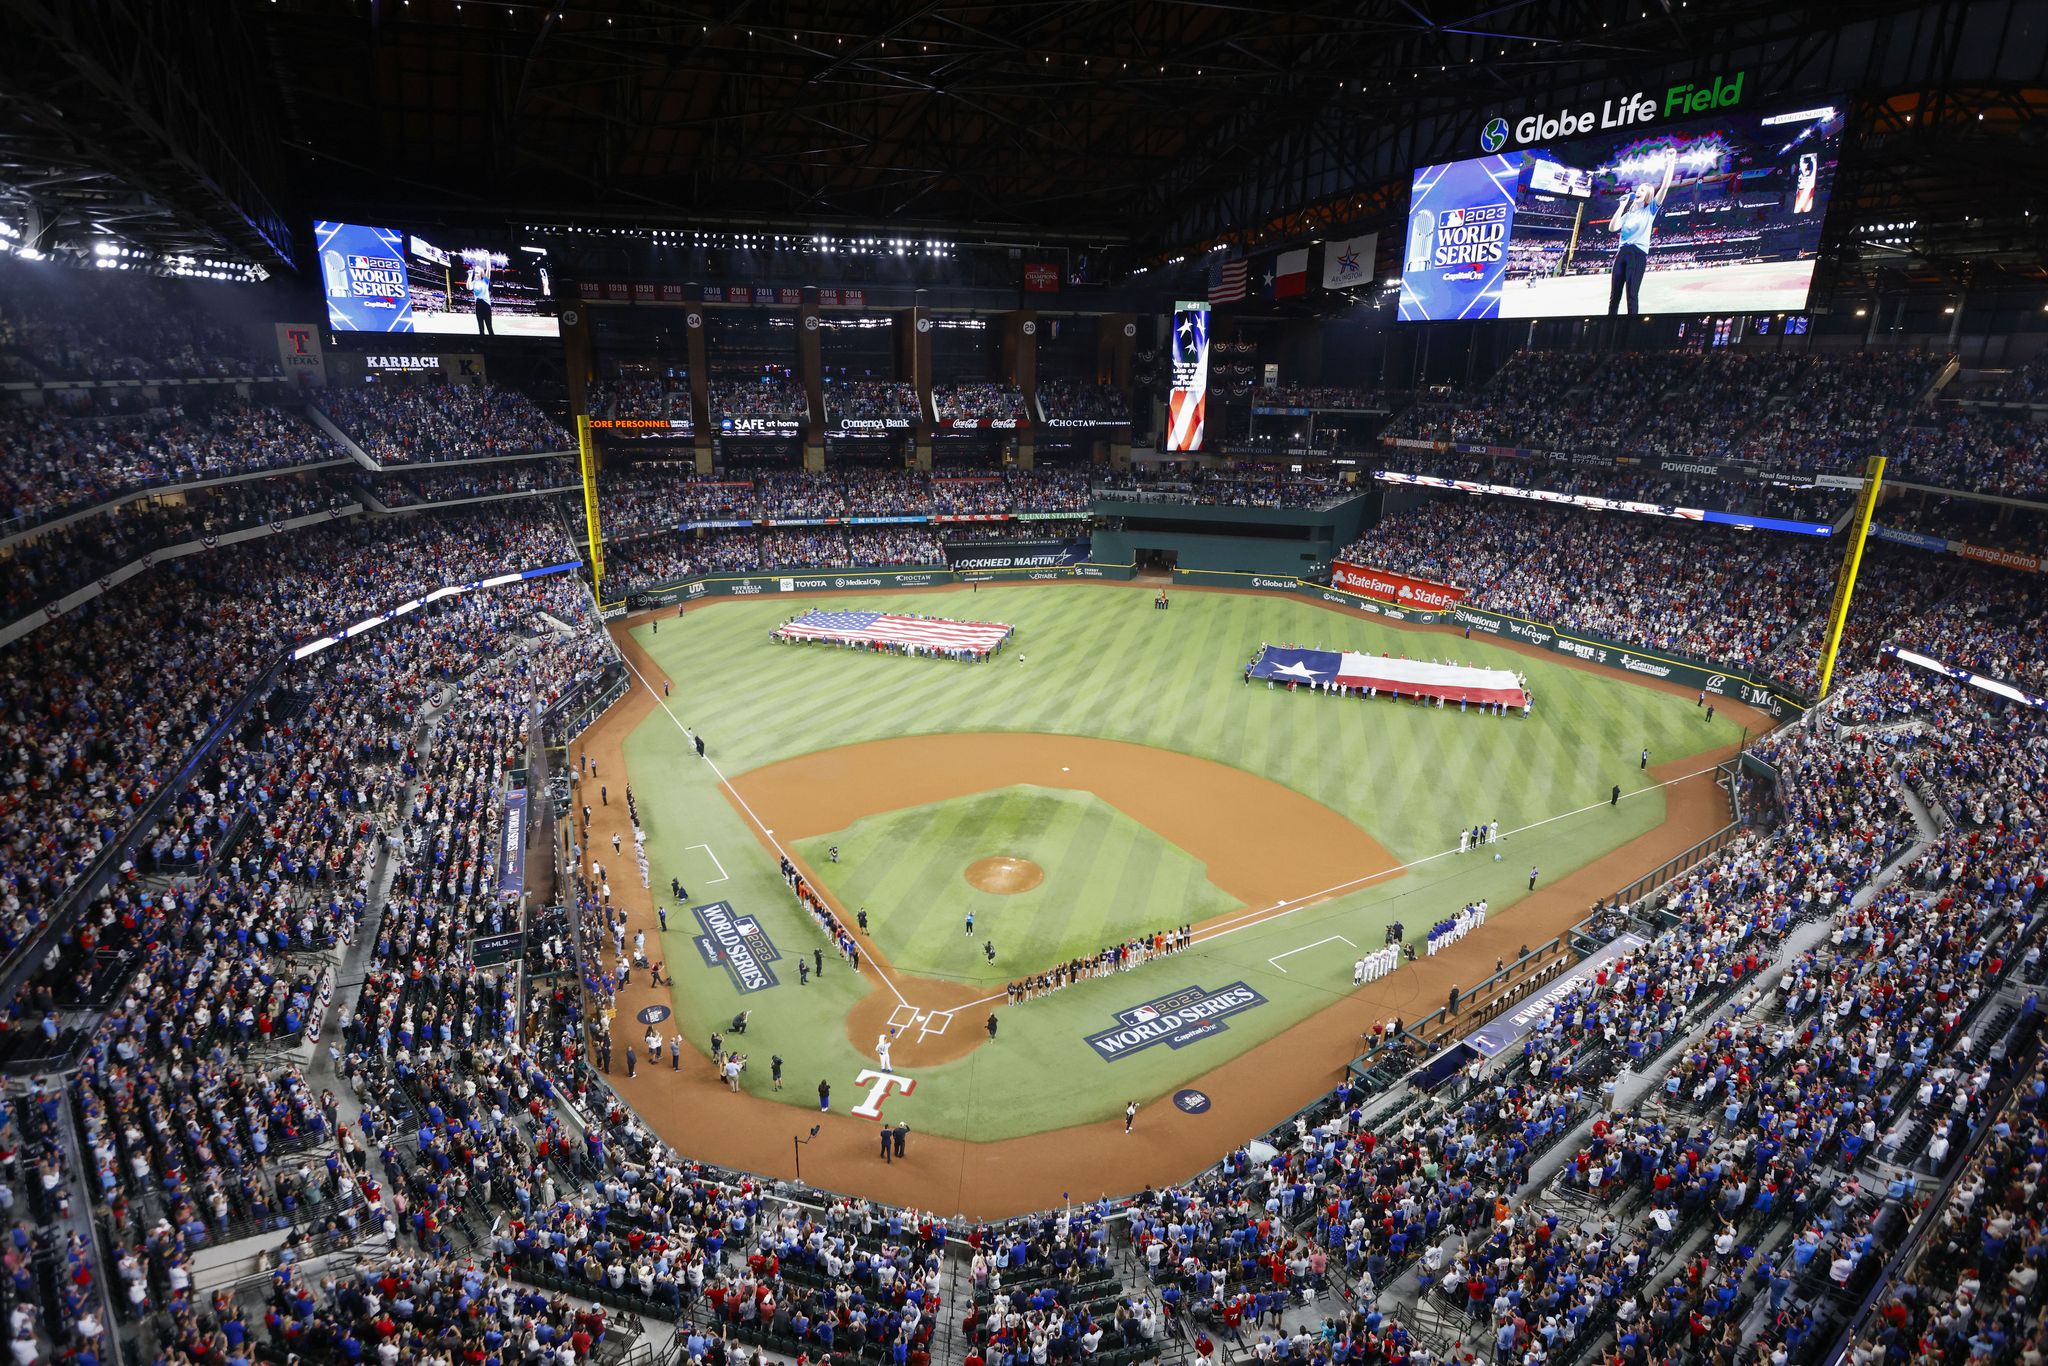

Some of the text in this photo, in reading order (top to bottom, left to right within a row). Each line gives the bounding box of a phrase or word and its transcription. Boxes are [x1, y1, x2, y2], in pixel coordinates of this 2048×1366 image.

[1515, 71, 1745, 144] Globe Life Field
[1465, 207, 1507, 222] 2023
[1438, 223, 1505, 247] WORLD
[1434, 241, 1504, 266] SERIES
[369, 260, 400, 269] 2023
[349, 268, 403, 284] WORLD
[1025, 272, 1058, 280] CHAMPIONS
[351, 281, 406, 298] SERIES
[635, 284, 654, 293] 1999
[663, 285, 681, 293] 2010
[757, 288, 773, 296] 2011
[782, 289, 799, 297] 2012
[820, 290, 837, 298] 2015
[845, 291, 862, 299] 2016
[565, 313, 576, 323] 42
[689, 317, 700, 326] 34
[806, 318, 818, 328] 26
[920, 321, 927, 331] 7
[1025, 323, 1034, 332] 29
[1126, 324, 1135, 334] 10
[287, 329, 310, 356] T
[287, 356, 319, 366] TEXAS
[366, 356, 440, 368] KARBACH
[590, 420, 613, 428] CORE
[615, 420, 670, 428] PERSONNEL
[735, 419, 765, 430] SAFE
[886, 418, 910, 428] Bank
[1053, 419, 1096, 427] CHOCTAW
[1549, 452, 1568, 460] PGL
[1661, 462, 1718, 475] POWERADE
[955, 556, 1055, 568] LOCKHEED MARTIN
[1967, 546, 2036, 569] orange.promo
[869, 578, 881, 586] City
[1262, 579, 1282, 587] Globe
[1283, 580, 1297, 589] Life
[689, 583, 705, 593] UTA
[1465, 613, 1500, 629] National
[1522, 625, 1551, 644] Kroger
[1574, 644, 1595, 656] BITE
[1634, 660, 1670, 673] Germania
[1705, 686, 1723, 694] SPORTS
[491, 940, 508, 948] MLB
[703, 905, 767, 989] WORLD SERIES
[747, 936, 771, 961] 2023
[1524, 974, 1586, 1018] WORLD SERIES
[1155, 991, 1204, 1012] 2023
[1095, 987, 1255, 1053] WORLD SERIES
[1474, 1035, 1495, 1048] T
[851, 1069, 917, 1121] T
